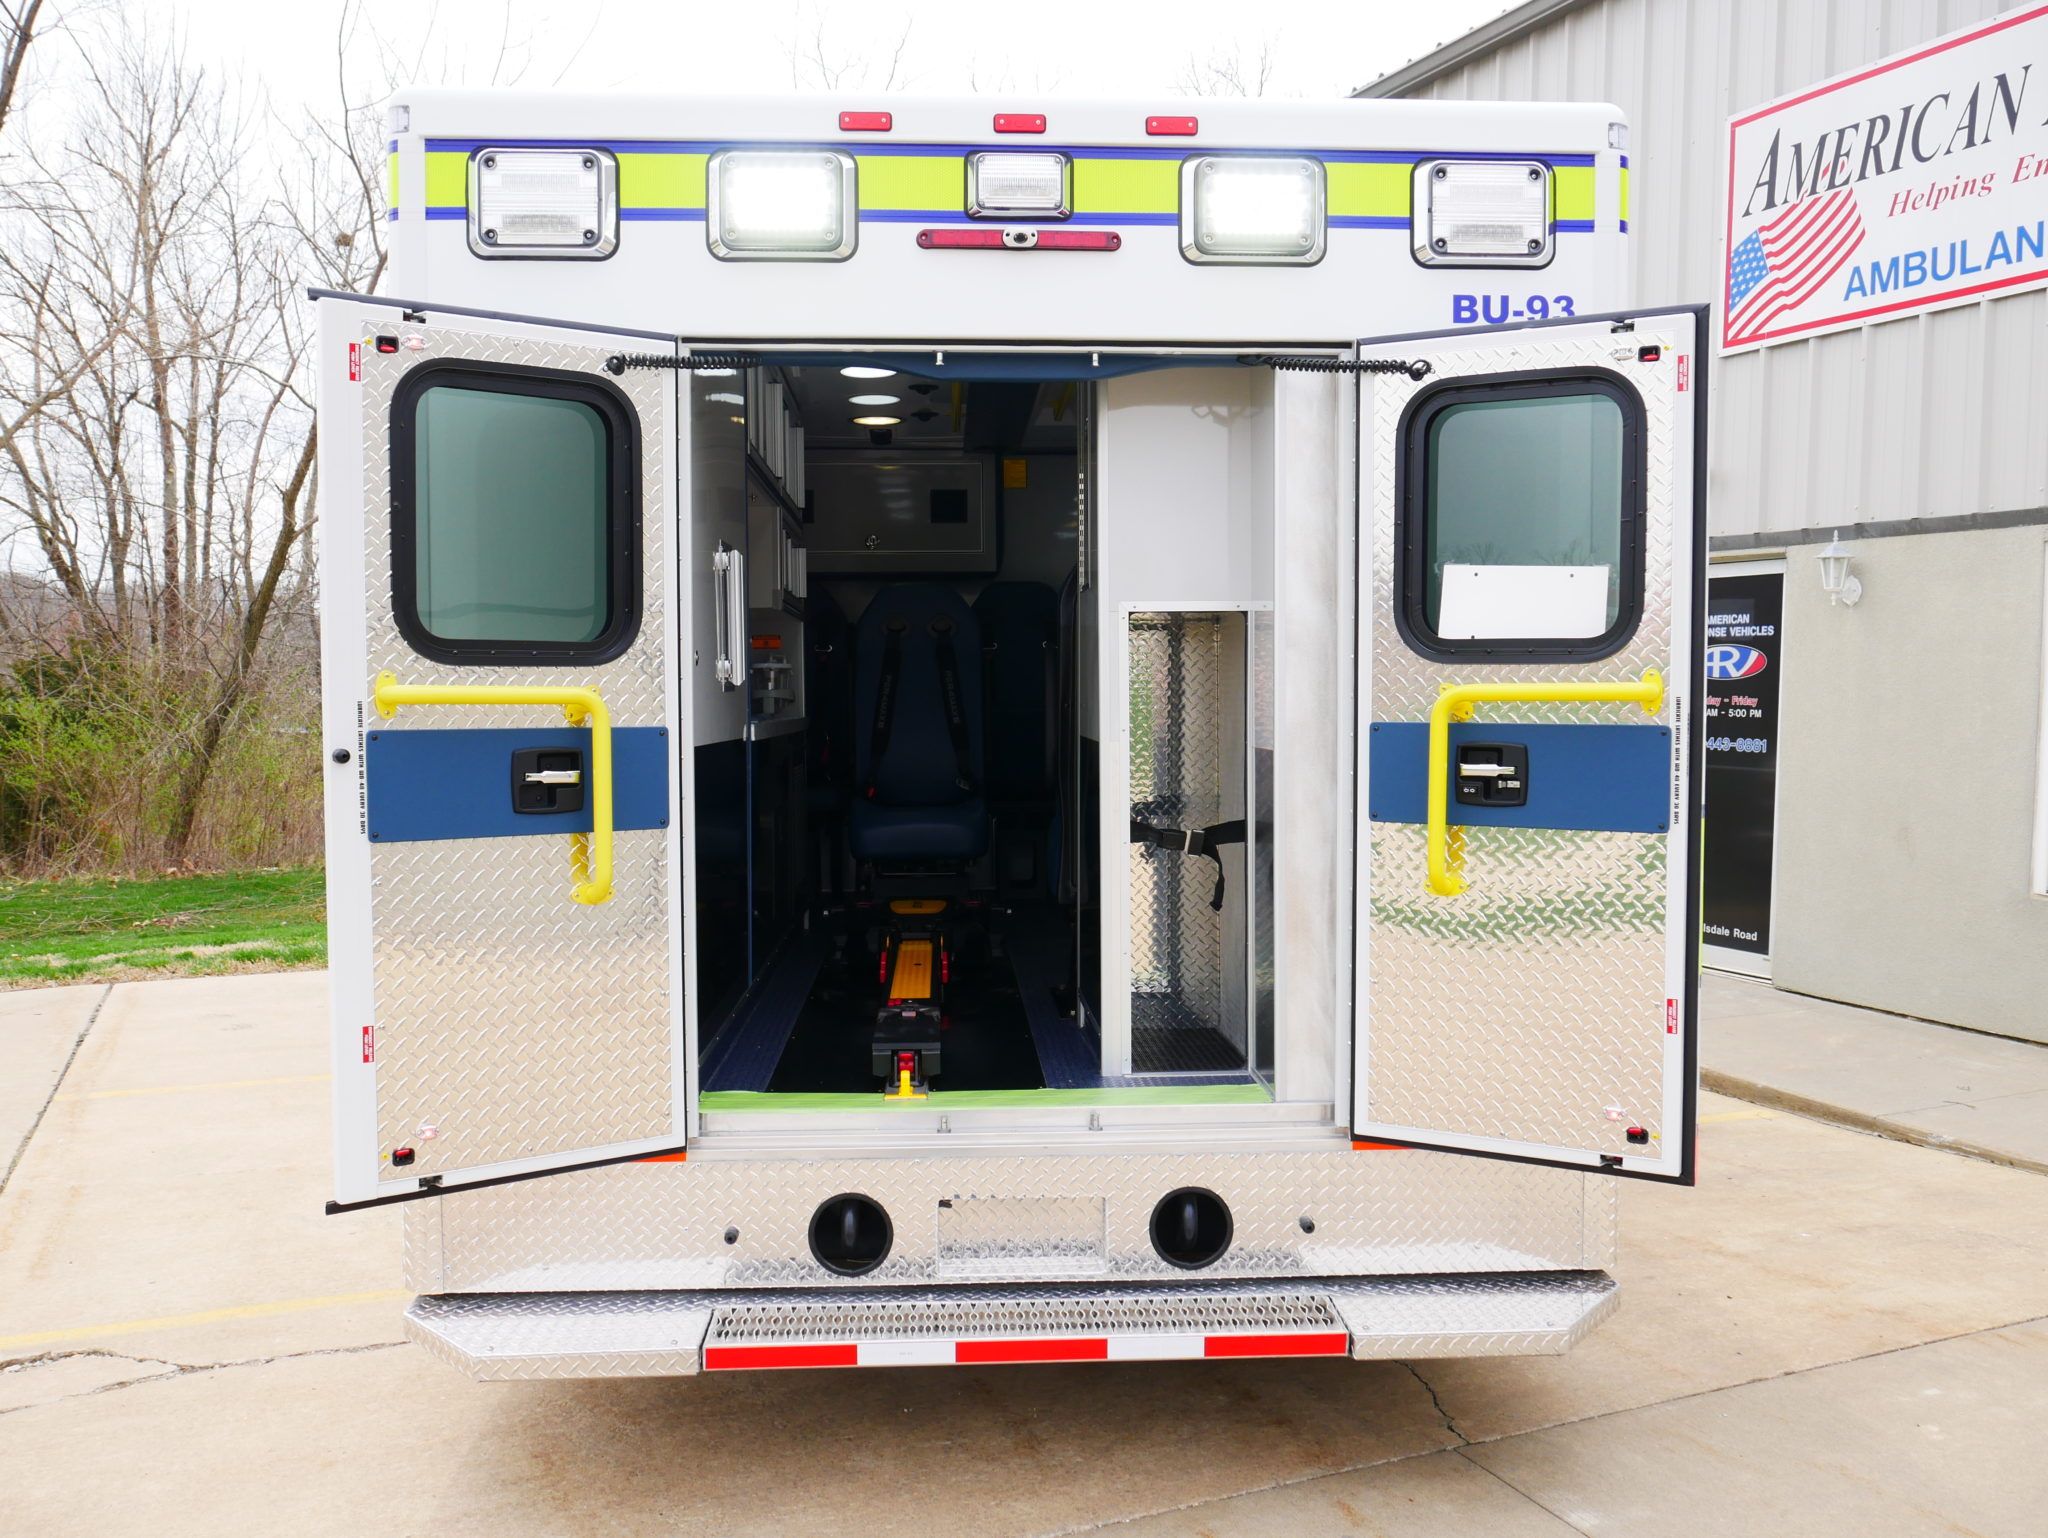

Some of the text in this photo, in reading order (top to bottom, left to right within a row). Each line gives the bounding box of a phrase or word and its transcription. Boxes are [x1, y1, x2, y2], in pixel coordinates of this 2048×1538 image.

[1742, 63, 2033, 218] AMERICAN
[1888, 172, 1997, 218] Helping
[1843, 220, 2045, 302] AMBULAN
[1452, 294, 1576, 324] BU-93
[1708, 625, 1775, 637] NSE VEHICLES
[1706, 695, 1722, 707] day
[1731, 695, 1759, 707] Friday
[1728, 708, 1747, 718] 5:00
[1749, 709, 1762, 718] PM
[1703, 923, 1758, 941] lsdale Road
